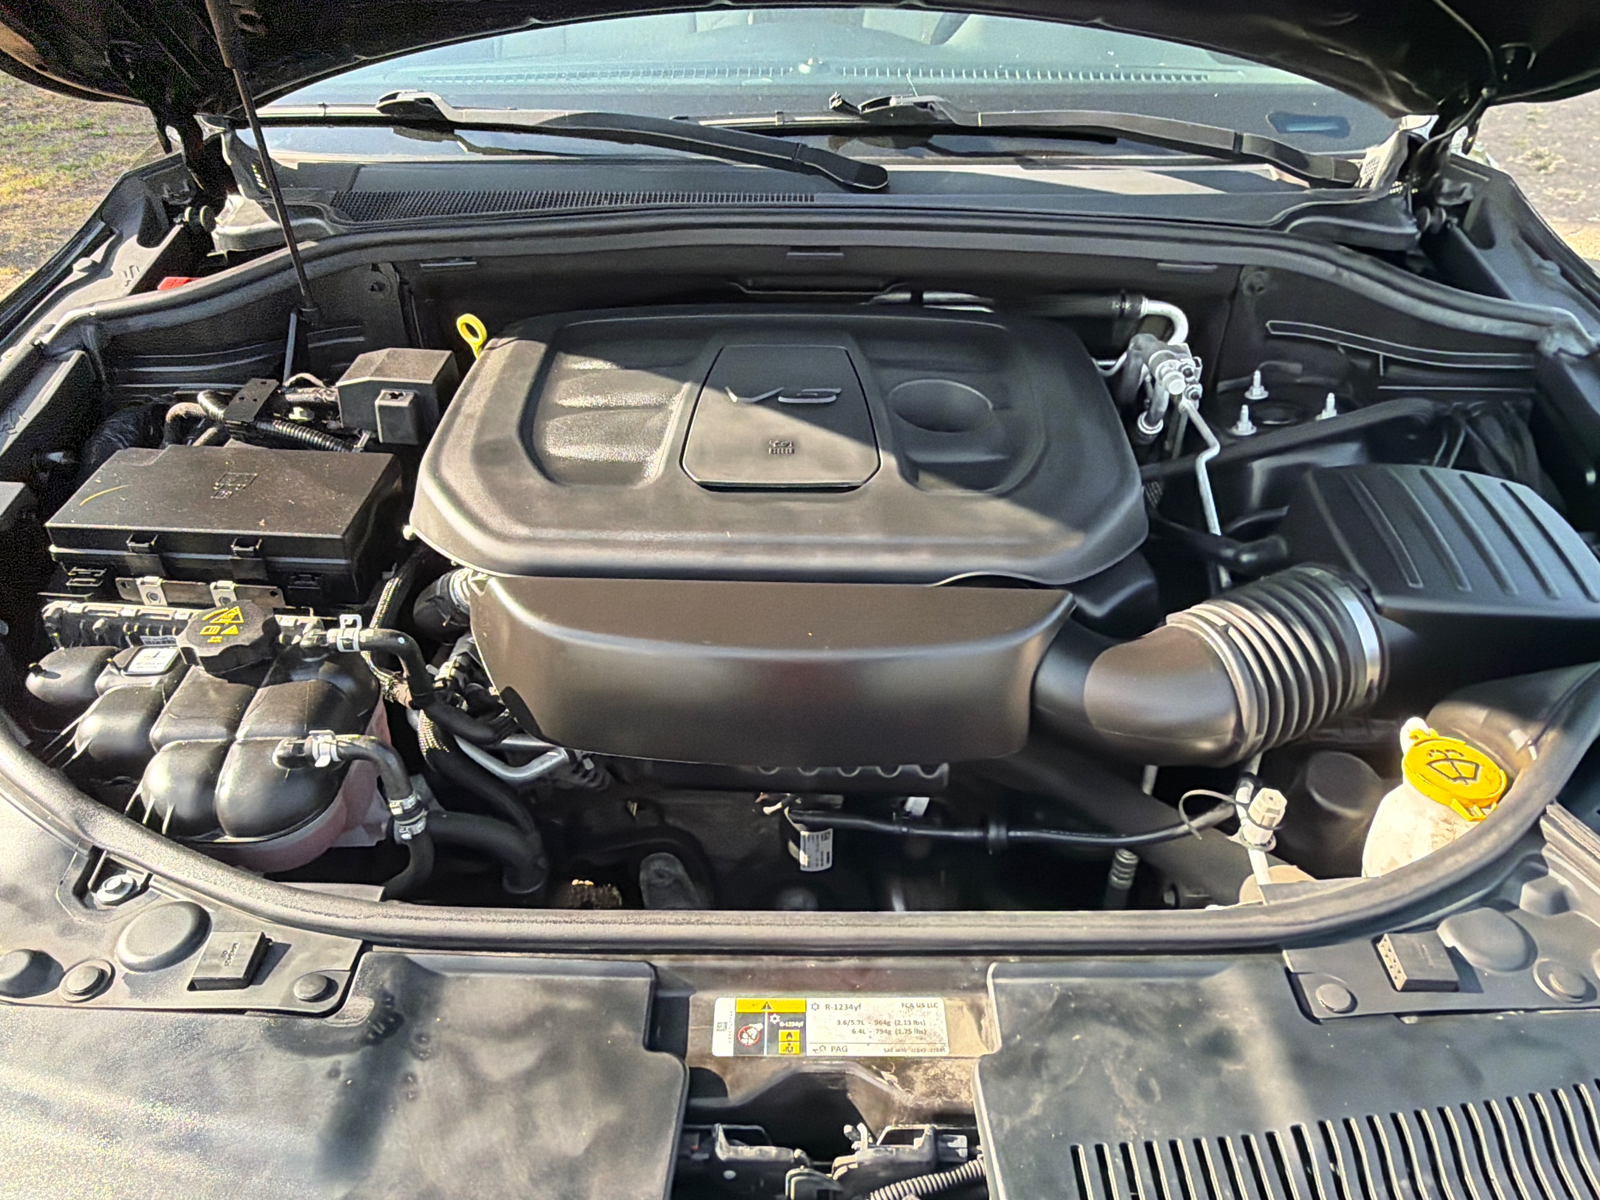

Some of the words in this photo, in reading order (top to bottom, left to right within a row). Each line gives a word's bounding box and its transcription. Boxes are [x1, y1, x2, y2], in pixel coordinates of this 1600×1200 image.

[825, 1003, 862, 1012] R-1234yf
[874, 1019, 891, 1027] 964g
[875, 1028, 892, 1036] 794g
[895, 1028, 913, 1036] (1.75
[914, 1028, 927, 1036] lbs)
